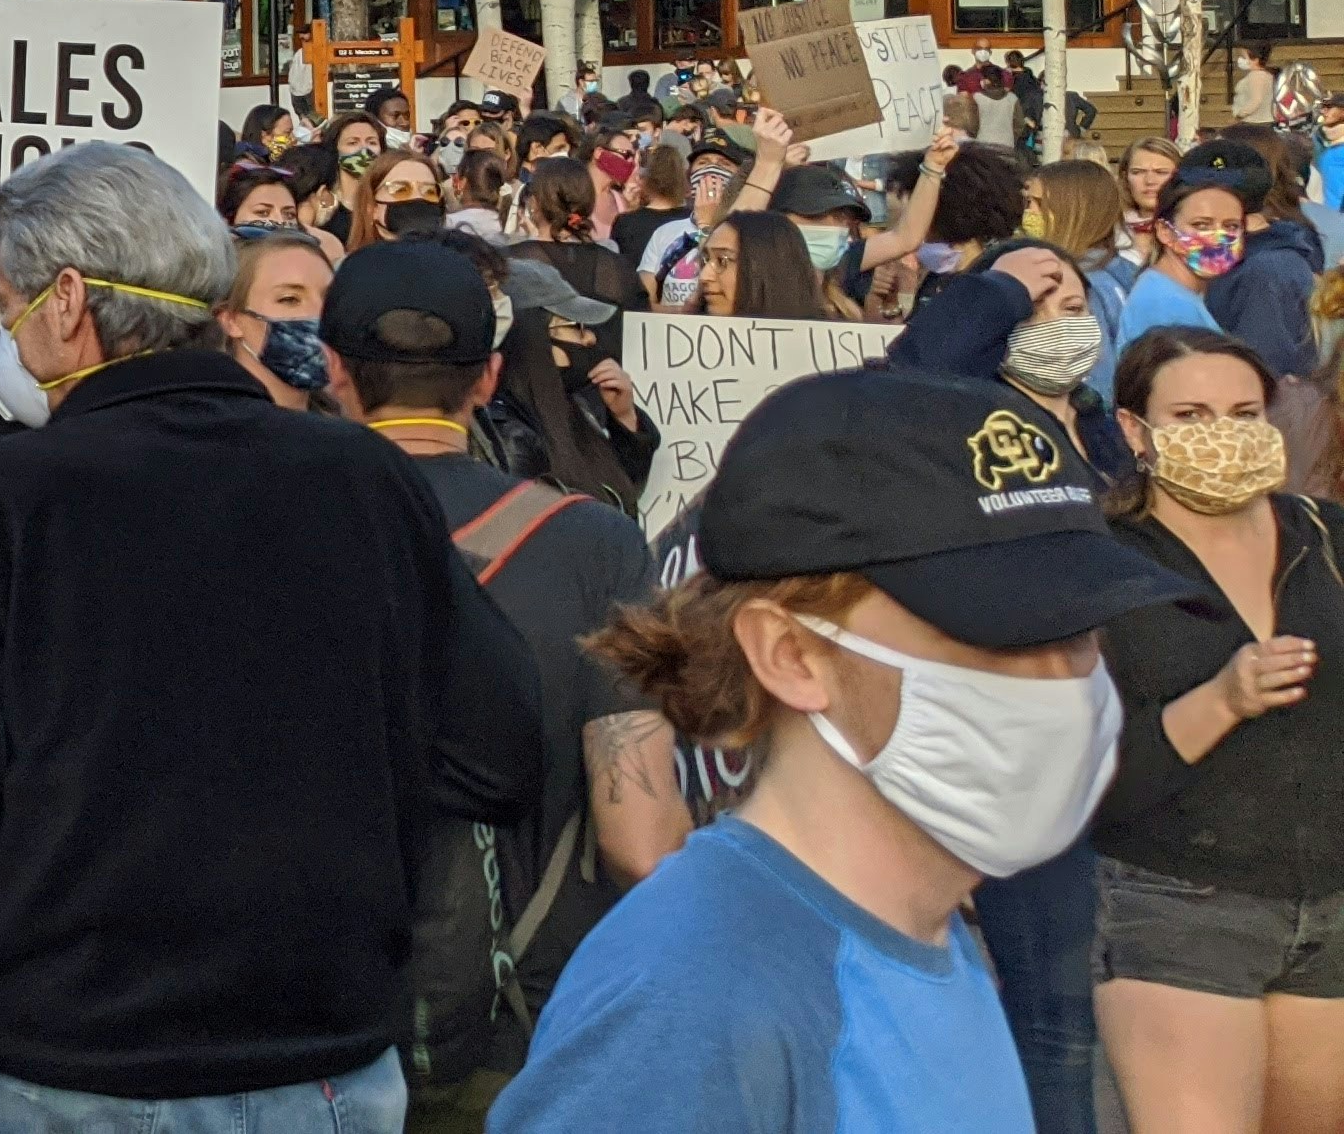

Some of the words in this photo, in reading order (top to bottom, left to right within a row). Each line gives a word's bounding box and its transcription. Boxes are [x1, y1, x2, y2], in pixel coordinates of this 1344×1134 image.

[492, 34, 543, 62] DEFEND
[855, 24, 936, 62] USTICE
[479, 63, 523, 86] LIVES
[491, 49, 531, 74] BLACK
[642, 322, 647, 370] I
[666, 321, 793, 370] DON'T
[632, 379, 742, 425] MAKE
[978, 487, 1068, 514] VOLUNTEER
